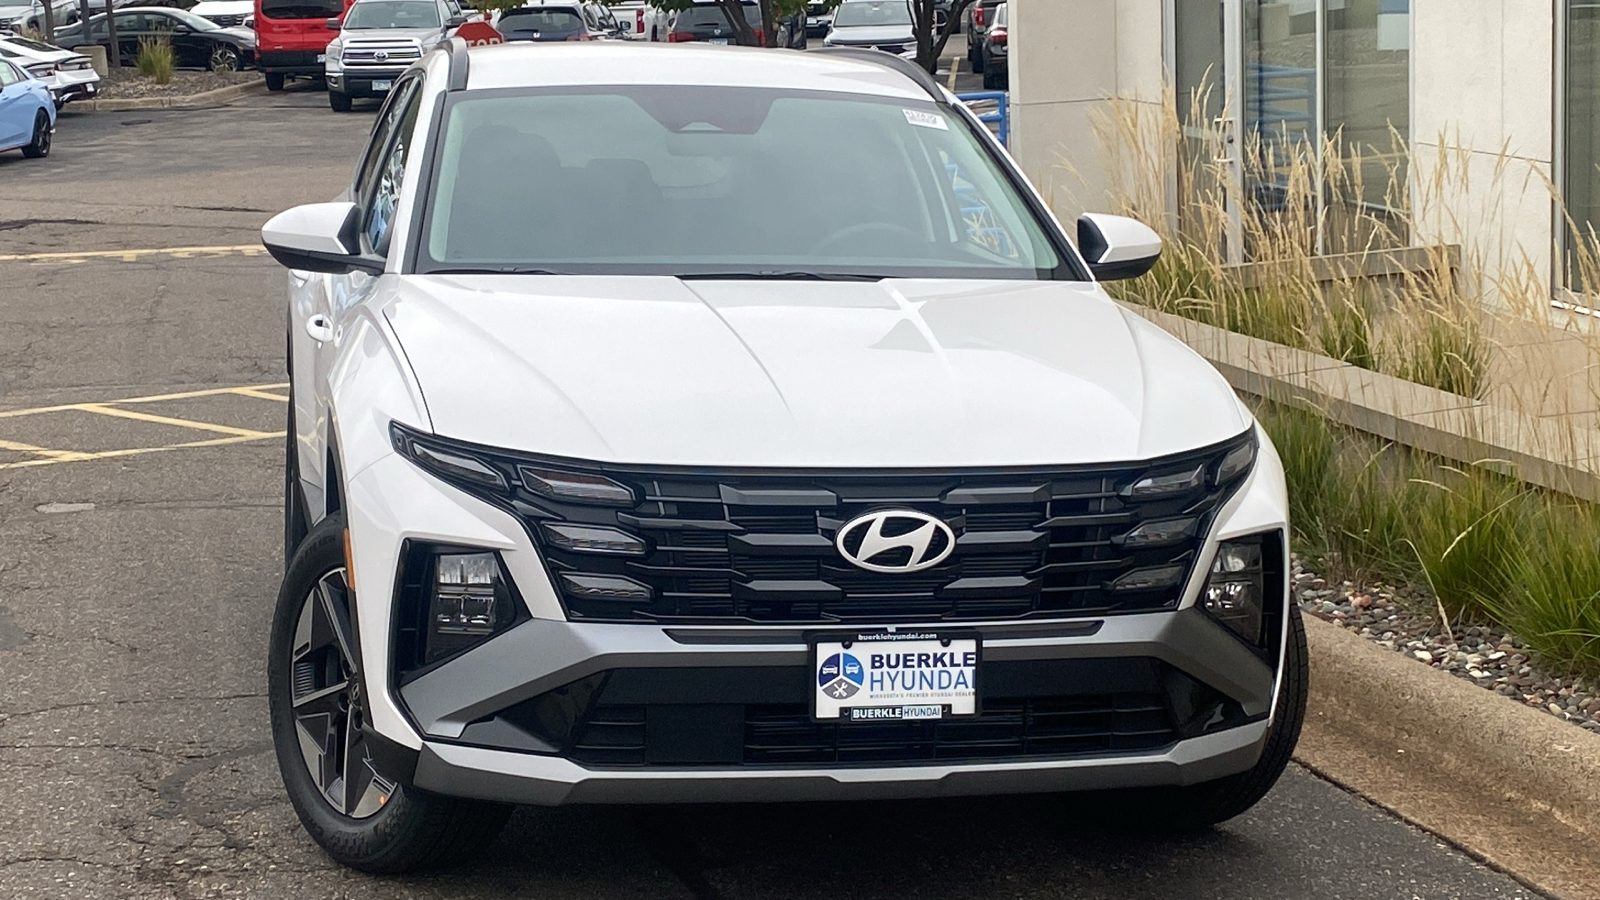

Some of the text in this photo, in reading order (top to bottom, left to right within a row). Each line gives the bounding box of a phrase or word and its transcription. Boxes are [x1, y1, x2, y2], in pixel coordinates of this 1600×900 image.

[858, 633, 937, 641] buerklehyundai.com
[870, 652, 976, 669] BUERKLE
[870, 669, 976, 691] HYUNDAI
[852, 707, 940, 719] BUERKLE HYUNDAI
